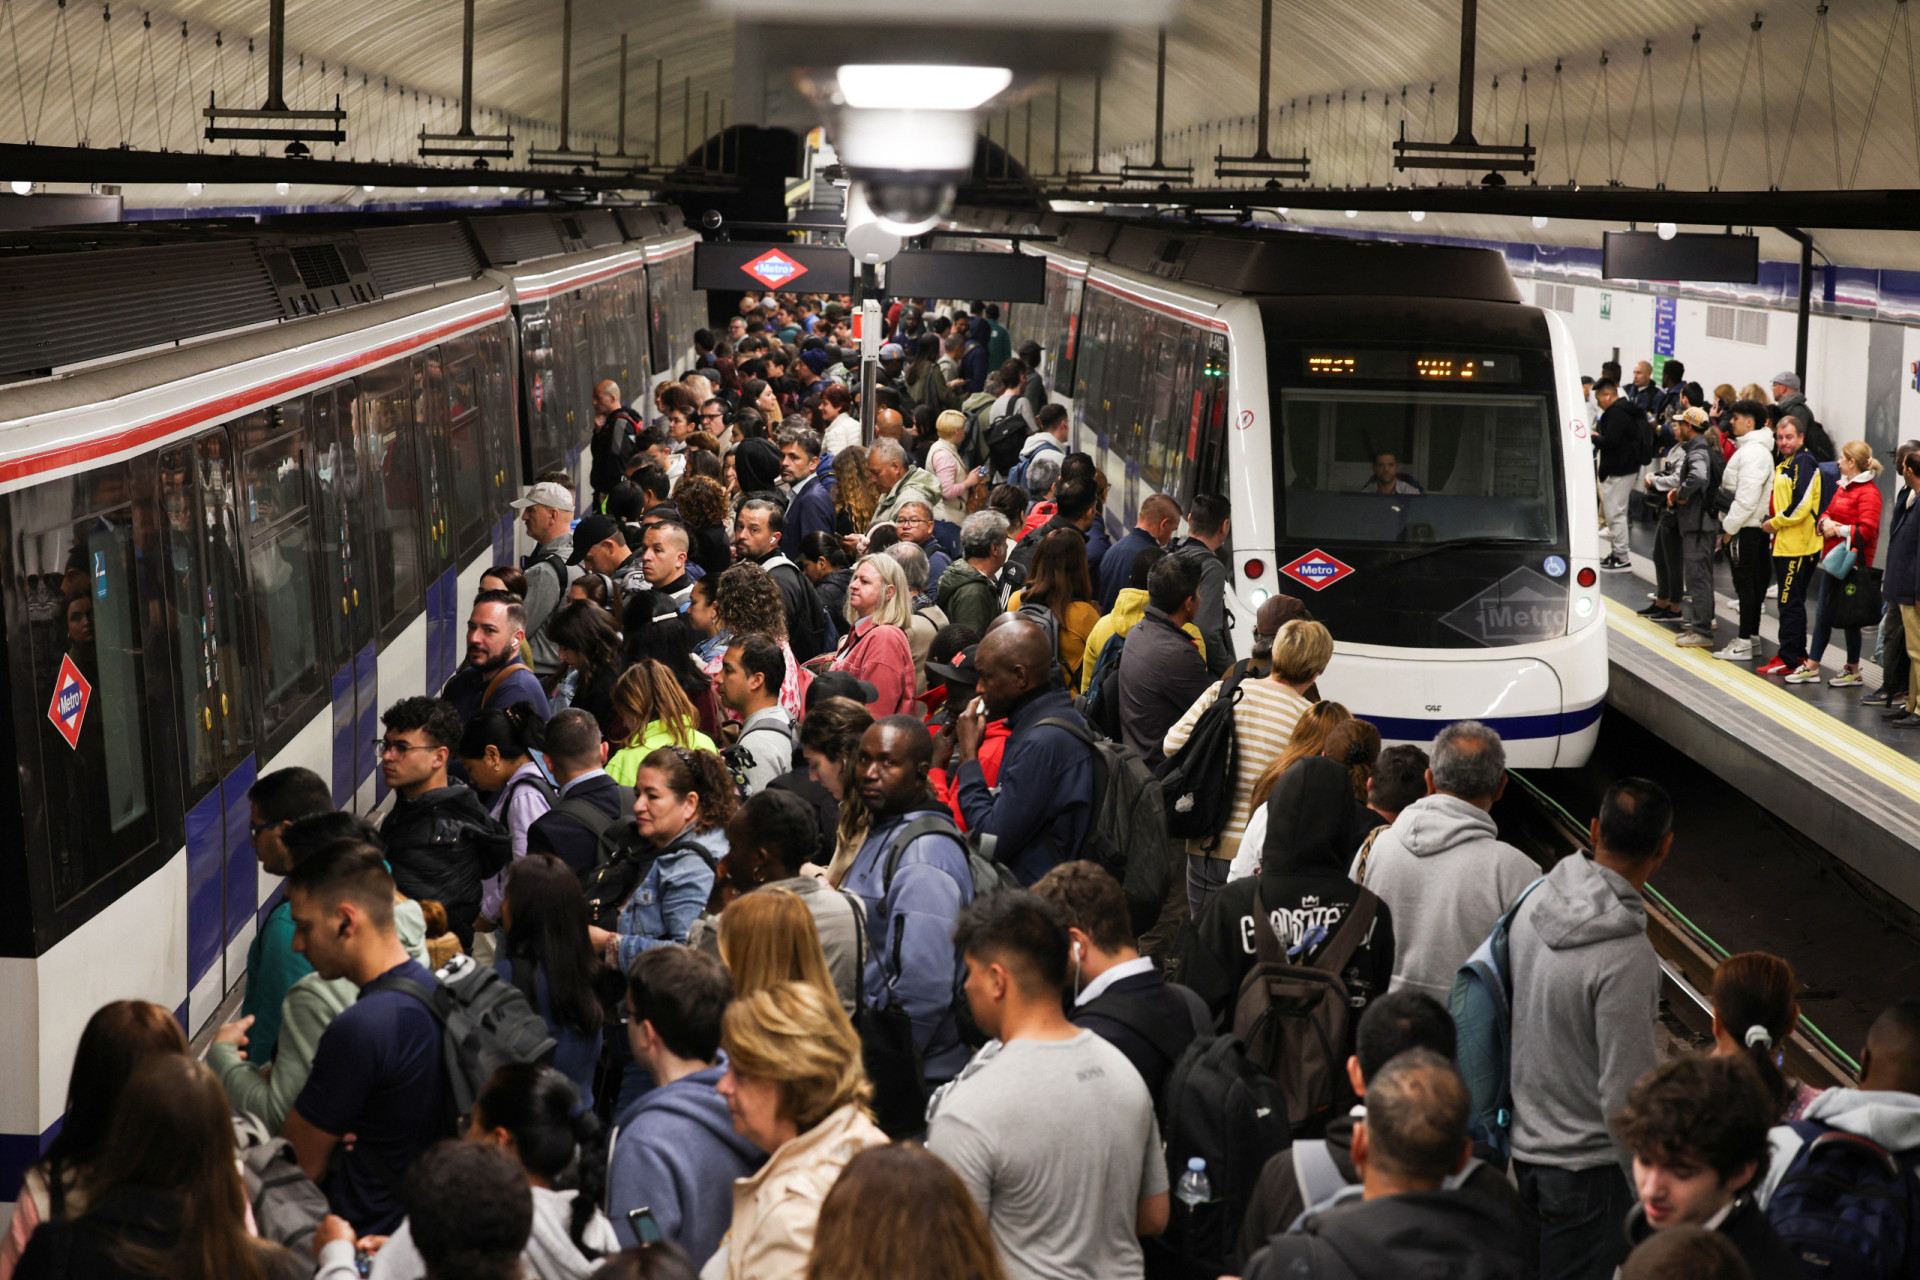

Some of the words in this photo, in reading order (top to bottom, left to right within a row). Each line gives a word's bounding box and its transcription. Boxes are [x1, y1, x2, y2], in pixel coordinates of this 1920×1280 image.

[760, 263, 789, 274] Metro
[1301, 565, 1333, 575] Metro
[1489, 605, 1567, 628] Metro
[60, 692, 80, 716] Metro
